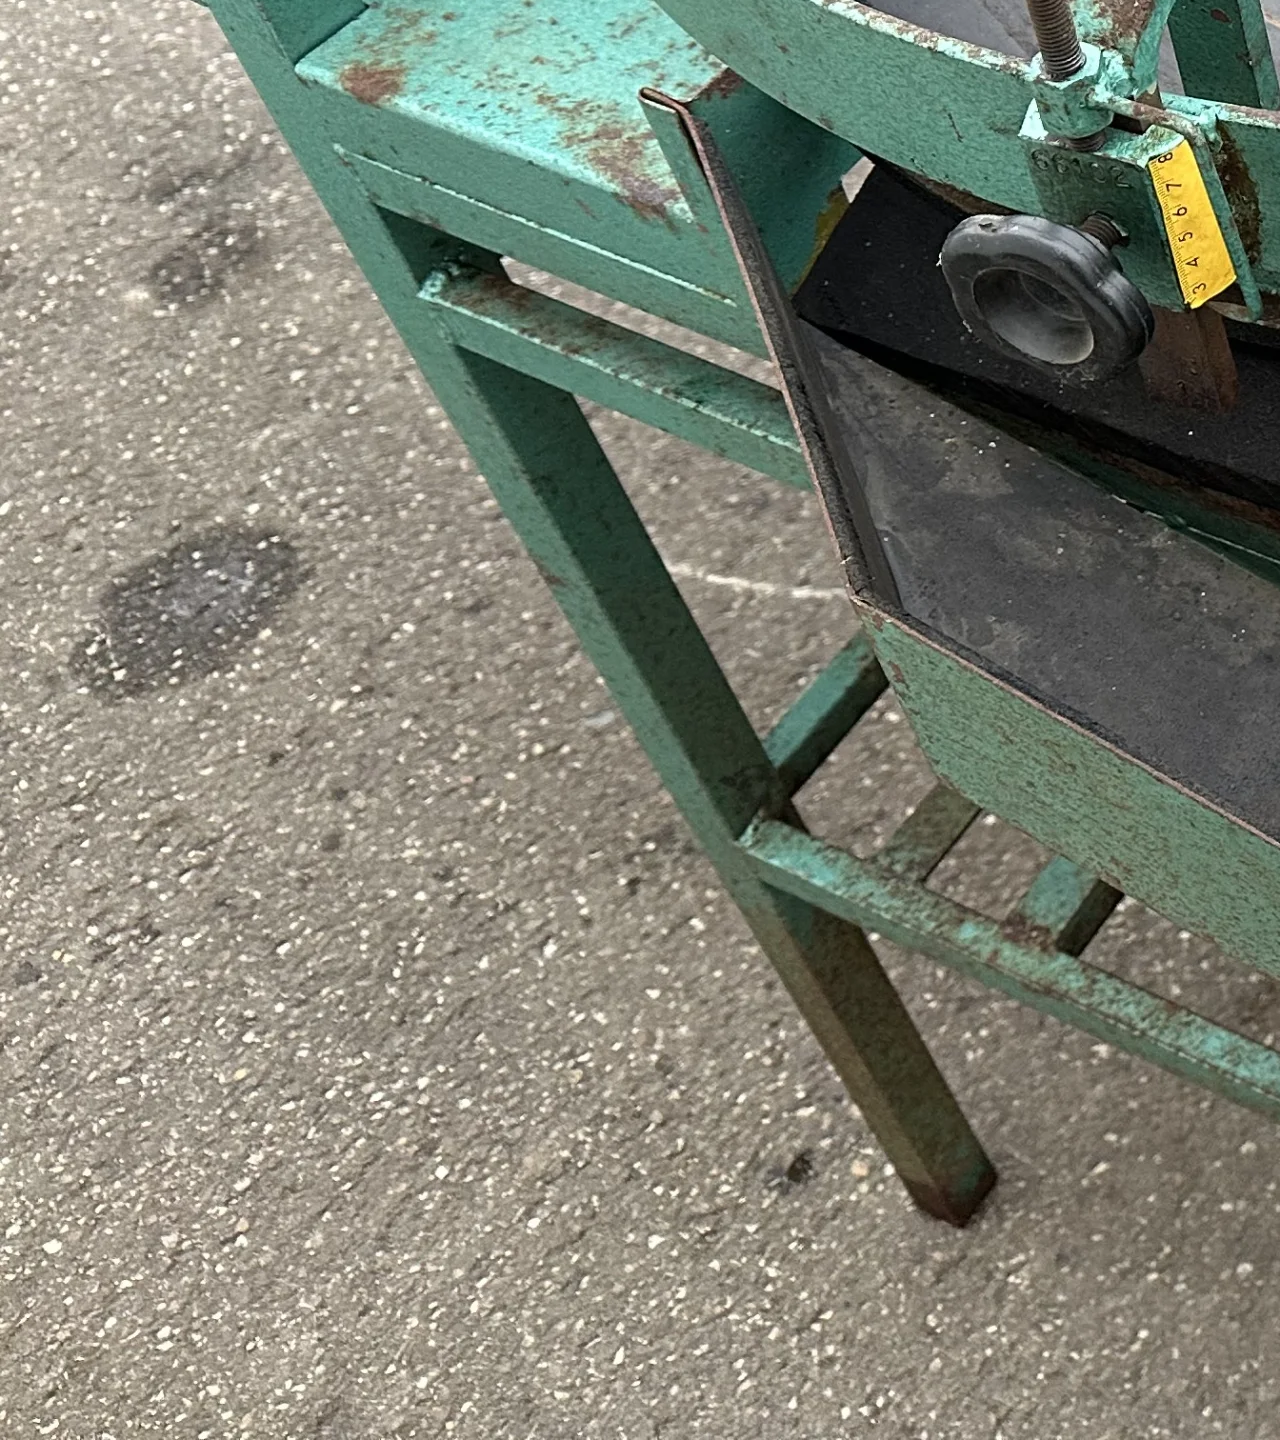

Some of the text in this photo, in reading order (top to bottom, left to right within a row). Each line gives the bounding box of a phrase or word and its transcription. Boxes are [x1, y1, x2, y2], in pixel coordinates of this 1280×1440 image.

[1157, 152, 1173, 164] 8
[1172, 206, 1188, 217] 6
[1178, 231, 1194, 243] 5
[1185, 256, 1200, 267] 4
[1192, 282, 1206, 293] 3
